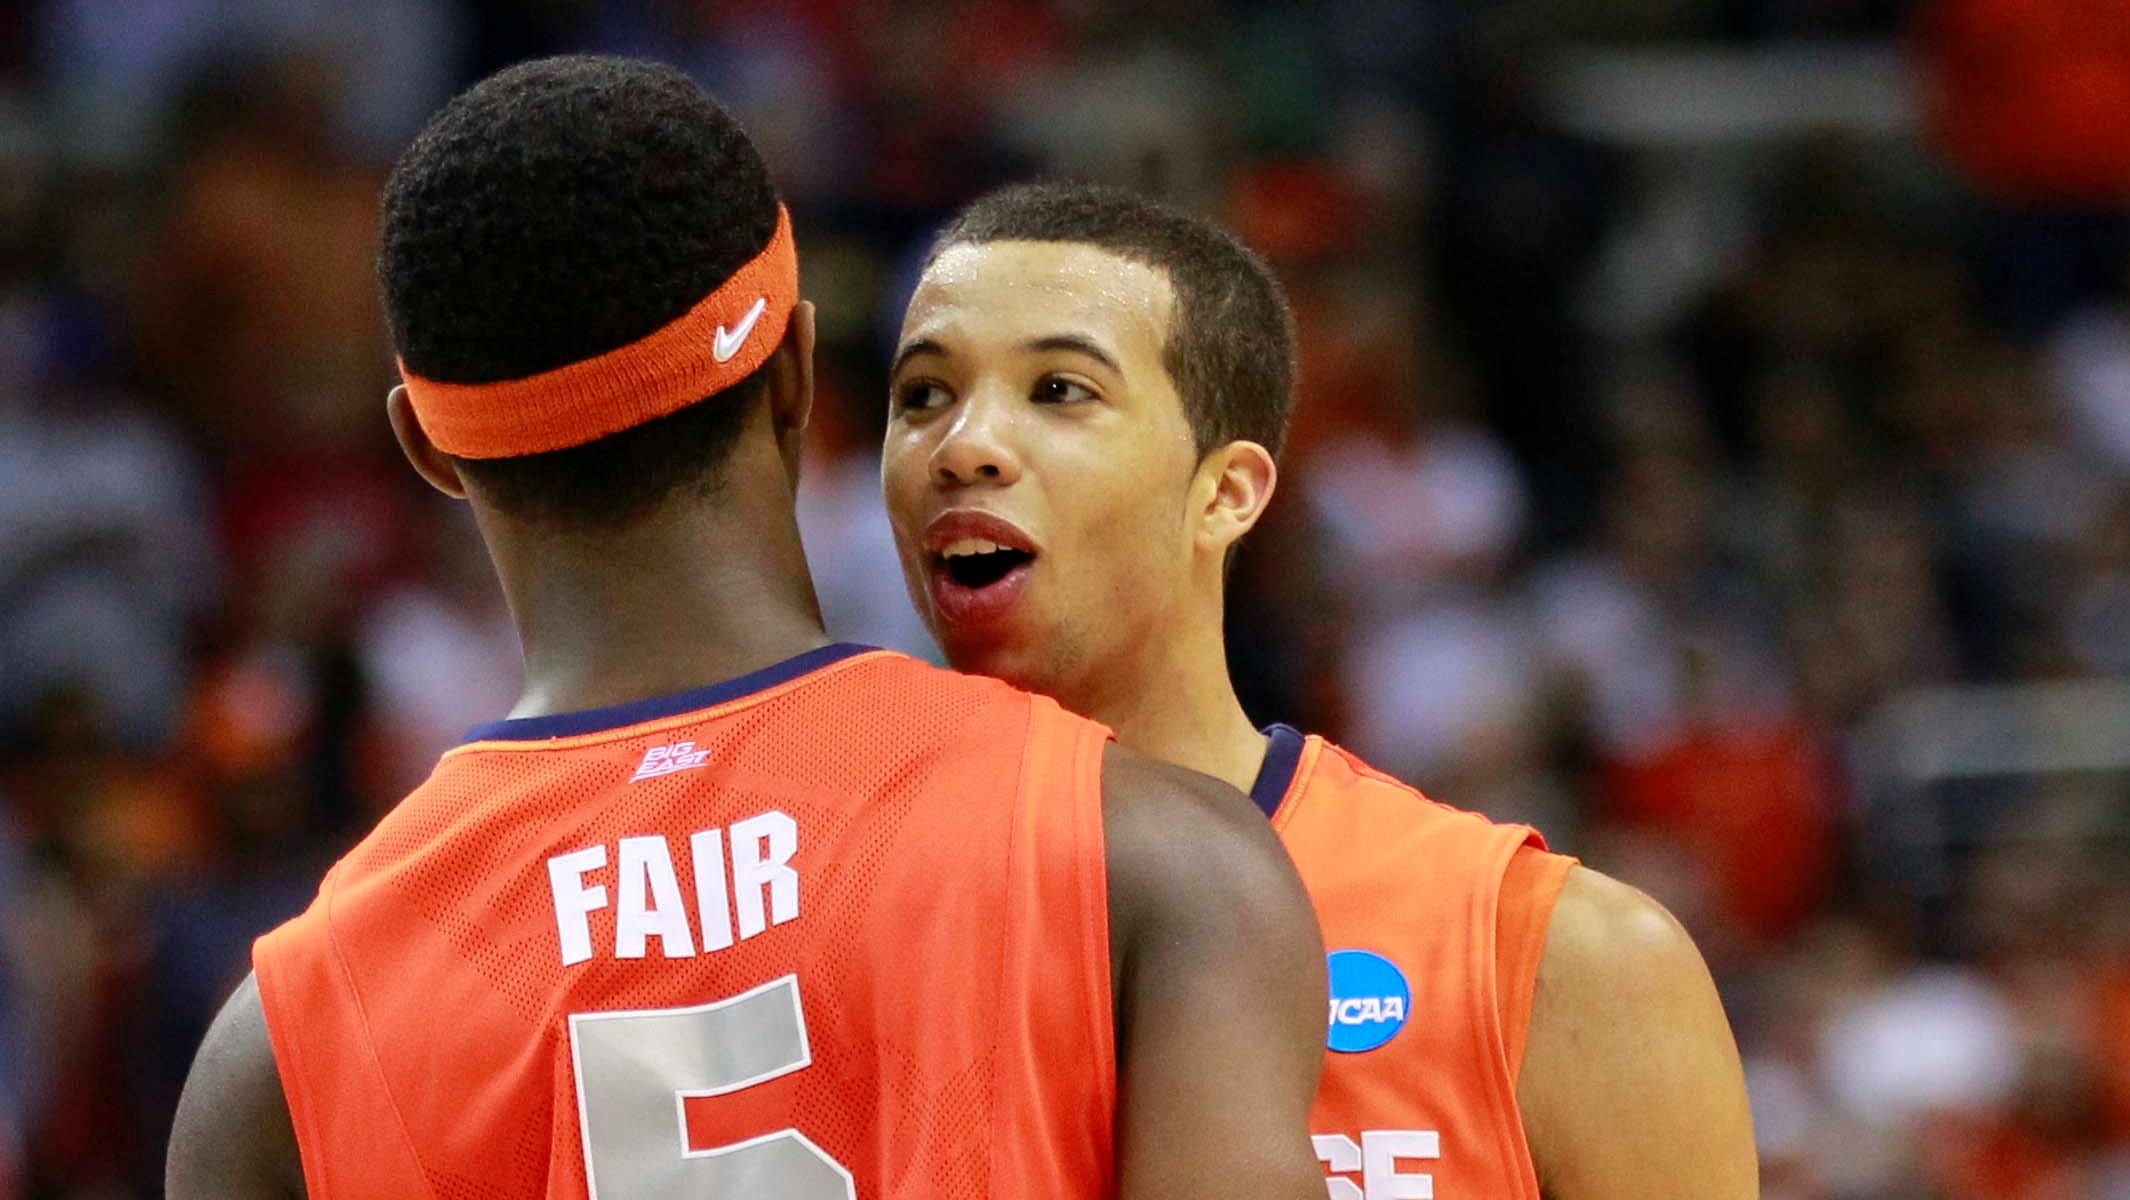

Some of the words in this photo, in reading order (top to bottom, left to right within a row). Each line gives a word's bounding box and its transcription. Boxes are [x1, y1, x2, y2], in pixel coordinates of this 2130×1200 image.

[635, 750, 711, 775] EAST
[642, 741, 696, 760] BIG
[547, 810, 799, 967] FAIR
[568, 973, 858, 1200] 5
